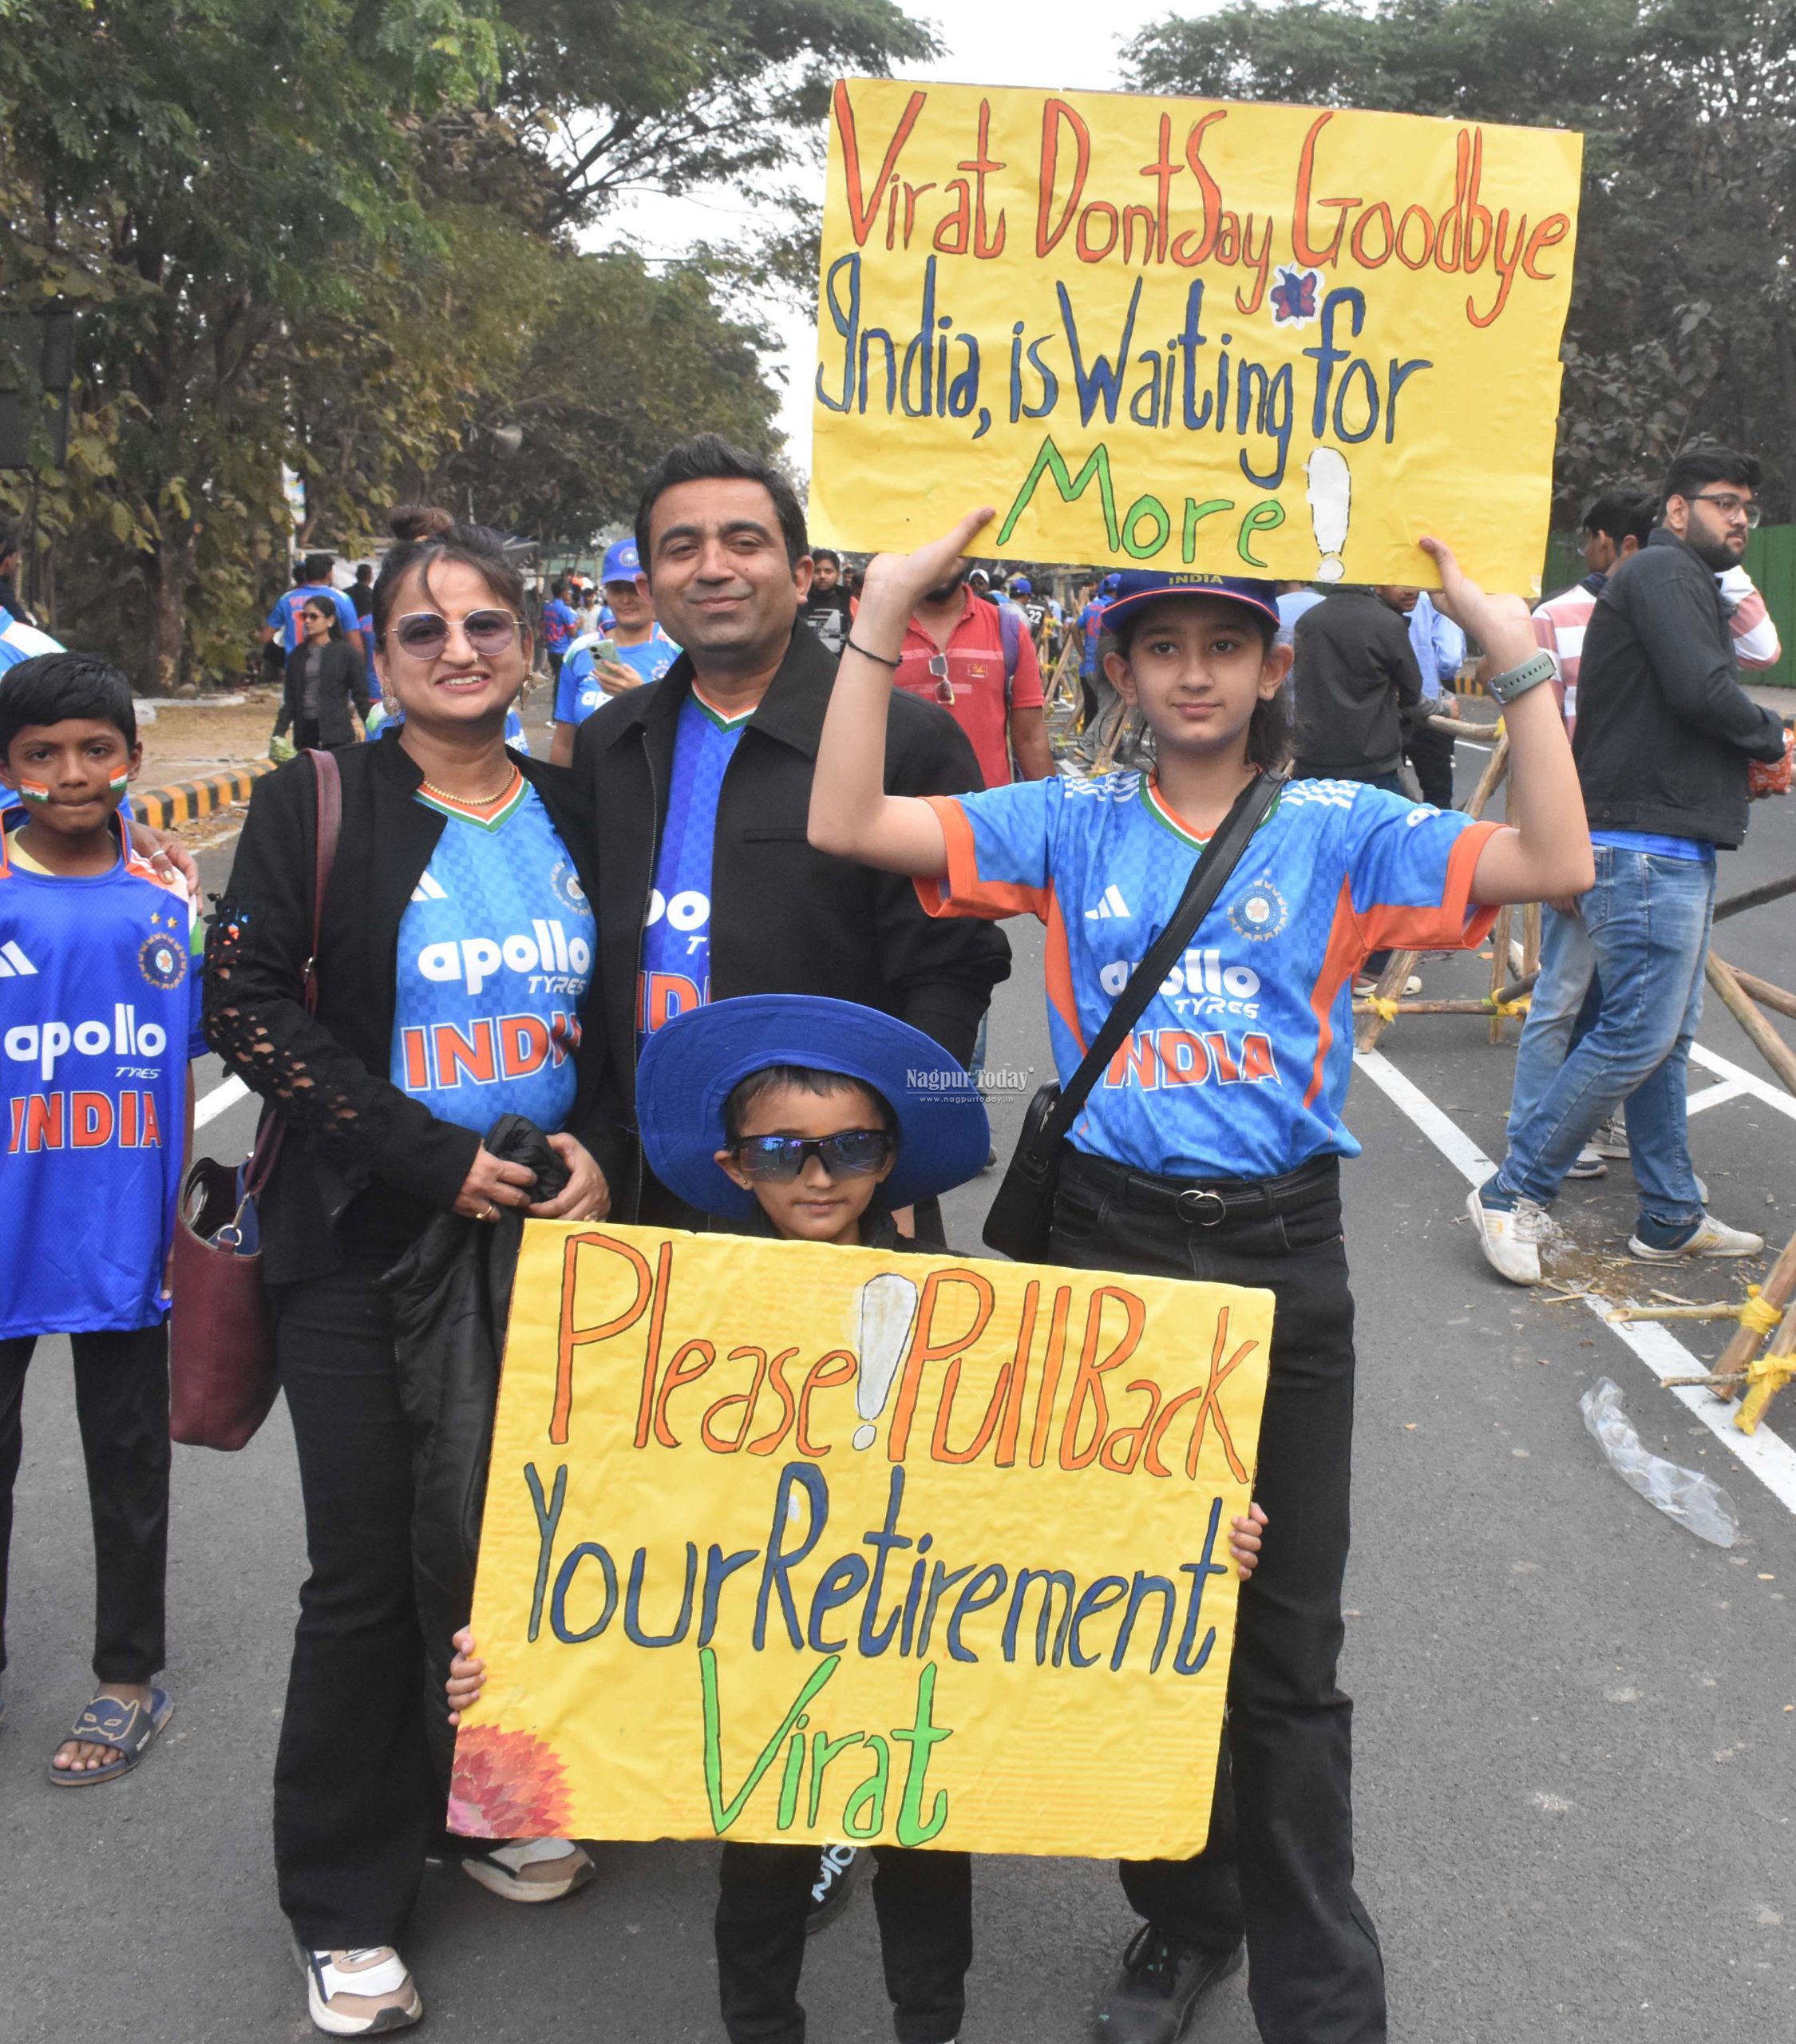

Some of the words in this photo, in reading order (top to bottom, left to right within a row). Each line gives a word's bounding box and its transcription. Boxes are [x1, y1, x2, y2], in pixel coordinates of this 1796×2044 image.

[833, 78, 1006, 259] Virat
[1292, 110, 1572, 328] Goodbye
[816, 252, 993, 439] India,
[1301, 285, 1433, 444] for
[1169, 574, 1224, 585] INDIA
[1028, 609, 1042, 624] 22
[417, 919, 590, 996] apollo
[528, 976, 587, 996] TYRES
[1100, 949, 1261, 999] aollo
[4, 1003, 166, 1081] apollo
[1174, 996, 1260, 1020] TYRES
[114, 1067, 161, 1079] TYRES
[7, 1091, 164, 1154] INDIA
[888, 1268, 1072, 1468] Pull
[523, 1461, 760, 1648] Your
[699, 1646, 954, 1848] Virat
